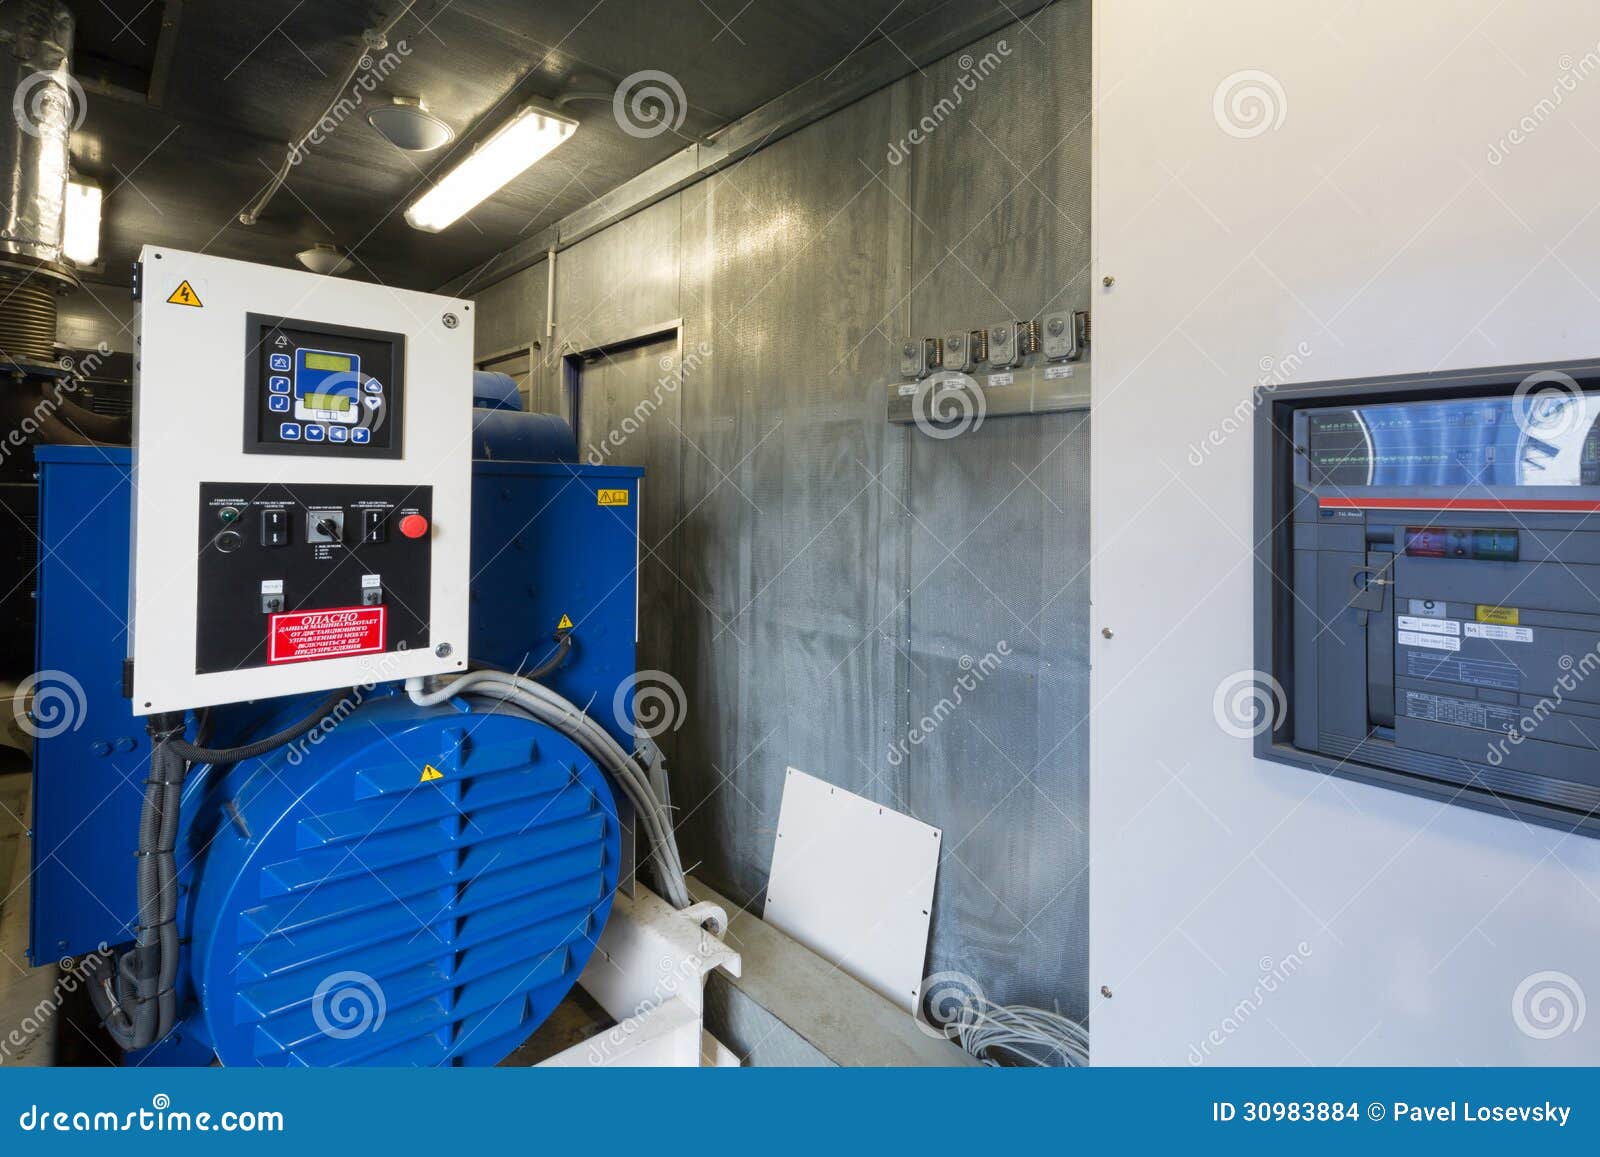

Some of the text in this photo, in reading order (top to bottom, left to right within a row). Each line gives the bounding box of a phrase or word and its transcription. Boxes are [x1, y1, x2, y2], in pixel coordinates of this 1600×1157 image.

[301, 612, 358, 626] ОПАСНО
[310, 621, 343, 630] МАШИНА
[344, 618, 378, 627] РАБОТАЕТ
